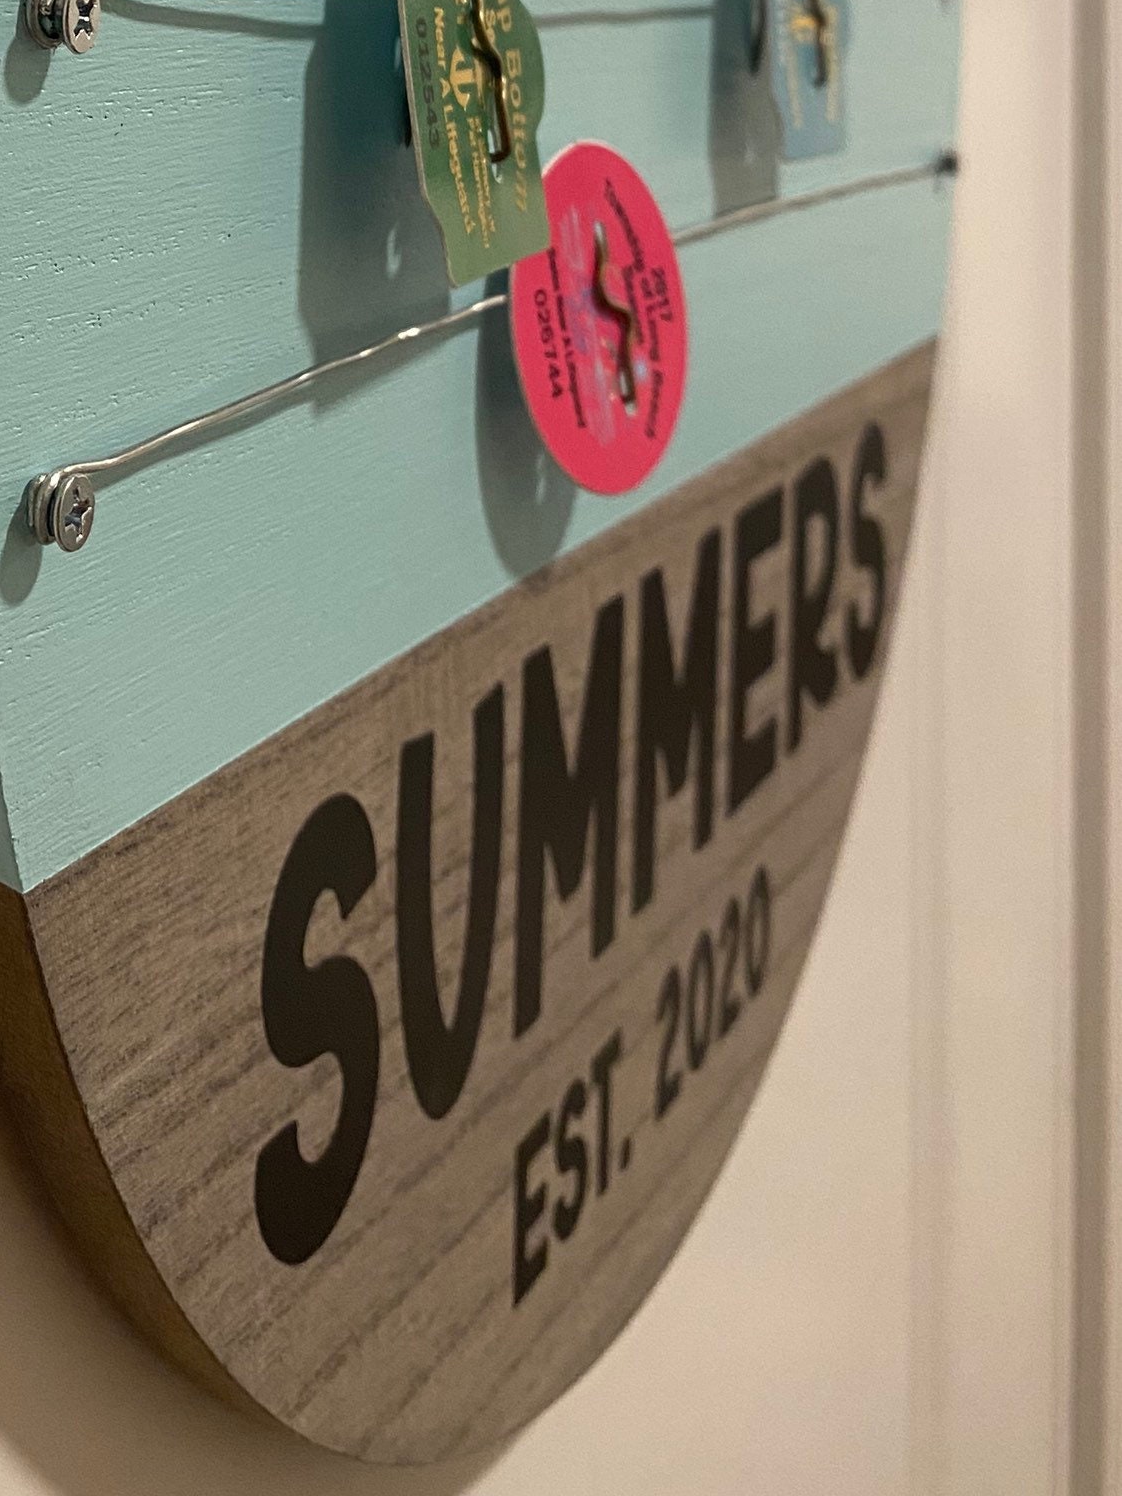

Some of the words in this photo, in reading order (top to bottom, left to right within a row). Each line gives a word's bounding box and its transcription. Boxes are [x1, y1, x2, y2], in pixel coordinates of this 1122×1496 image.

[415, 18, 439, 149] 012543
[434, 7, 446, 70] Near
[440, 78, 451, 99] A
[443, 105, 475, 234] Lifeguard
[505, 49, 527, 211] Bottom
[255, 421, 889, 1265] SUMMERS
[512, 1027, 634, 1307] EST.
[654, 863, 772, 1121] 2020
